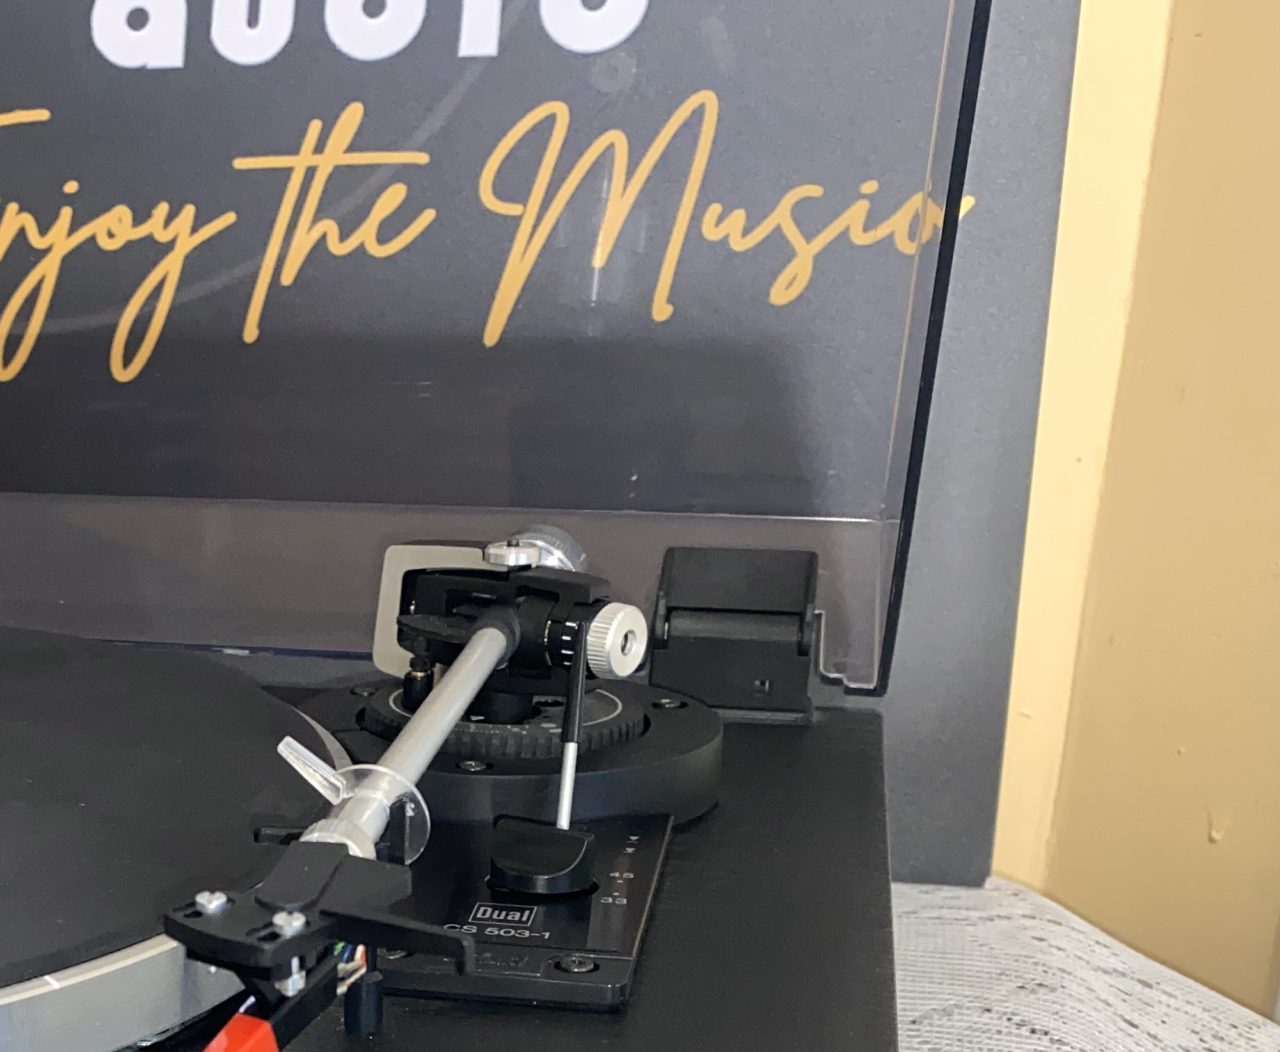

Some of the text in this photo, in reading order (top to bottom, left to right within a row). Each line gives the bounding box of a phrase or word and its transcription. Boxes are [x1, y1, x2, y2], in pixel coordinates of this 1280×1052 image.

[600, 896, 628, 905] 33
[475, 906, 531, 922] Dual
[443, 923, 551, 940] CS 503-1
